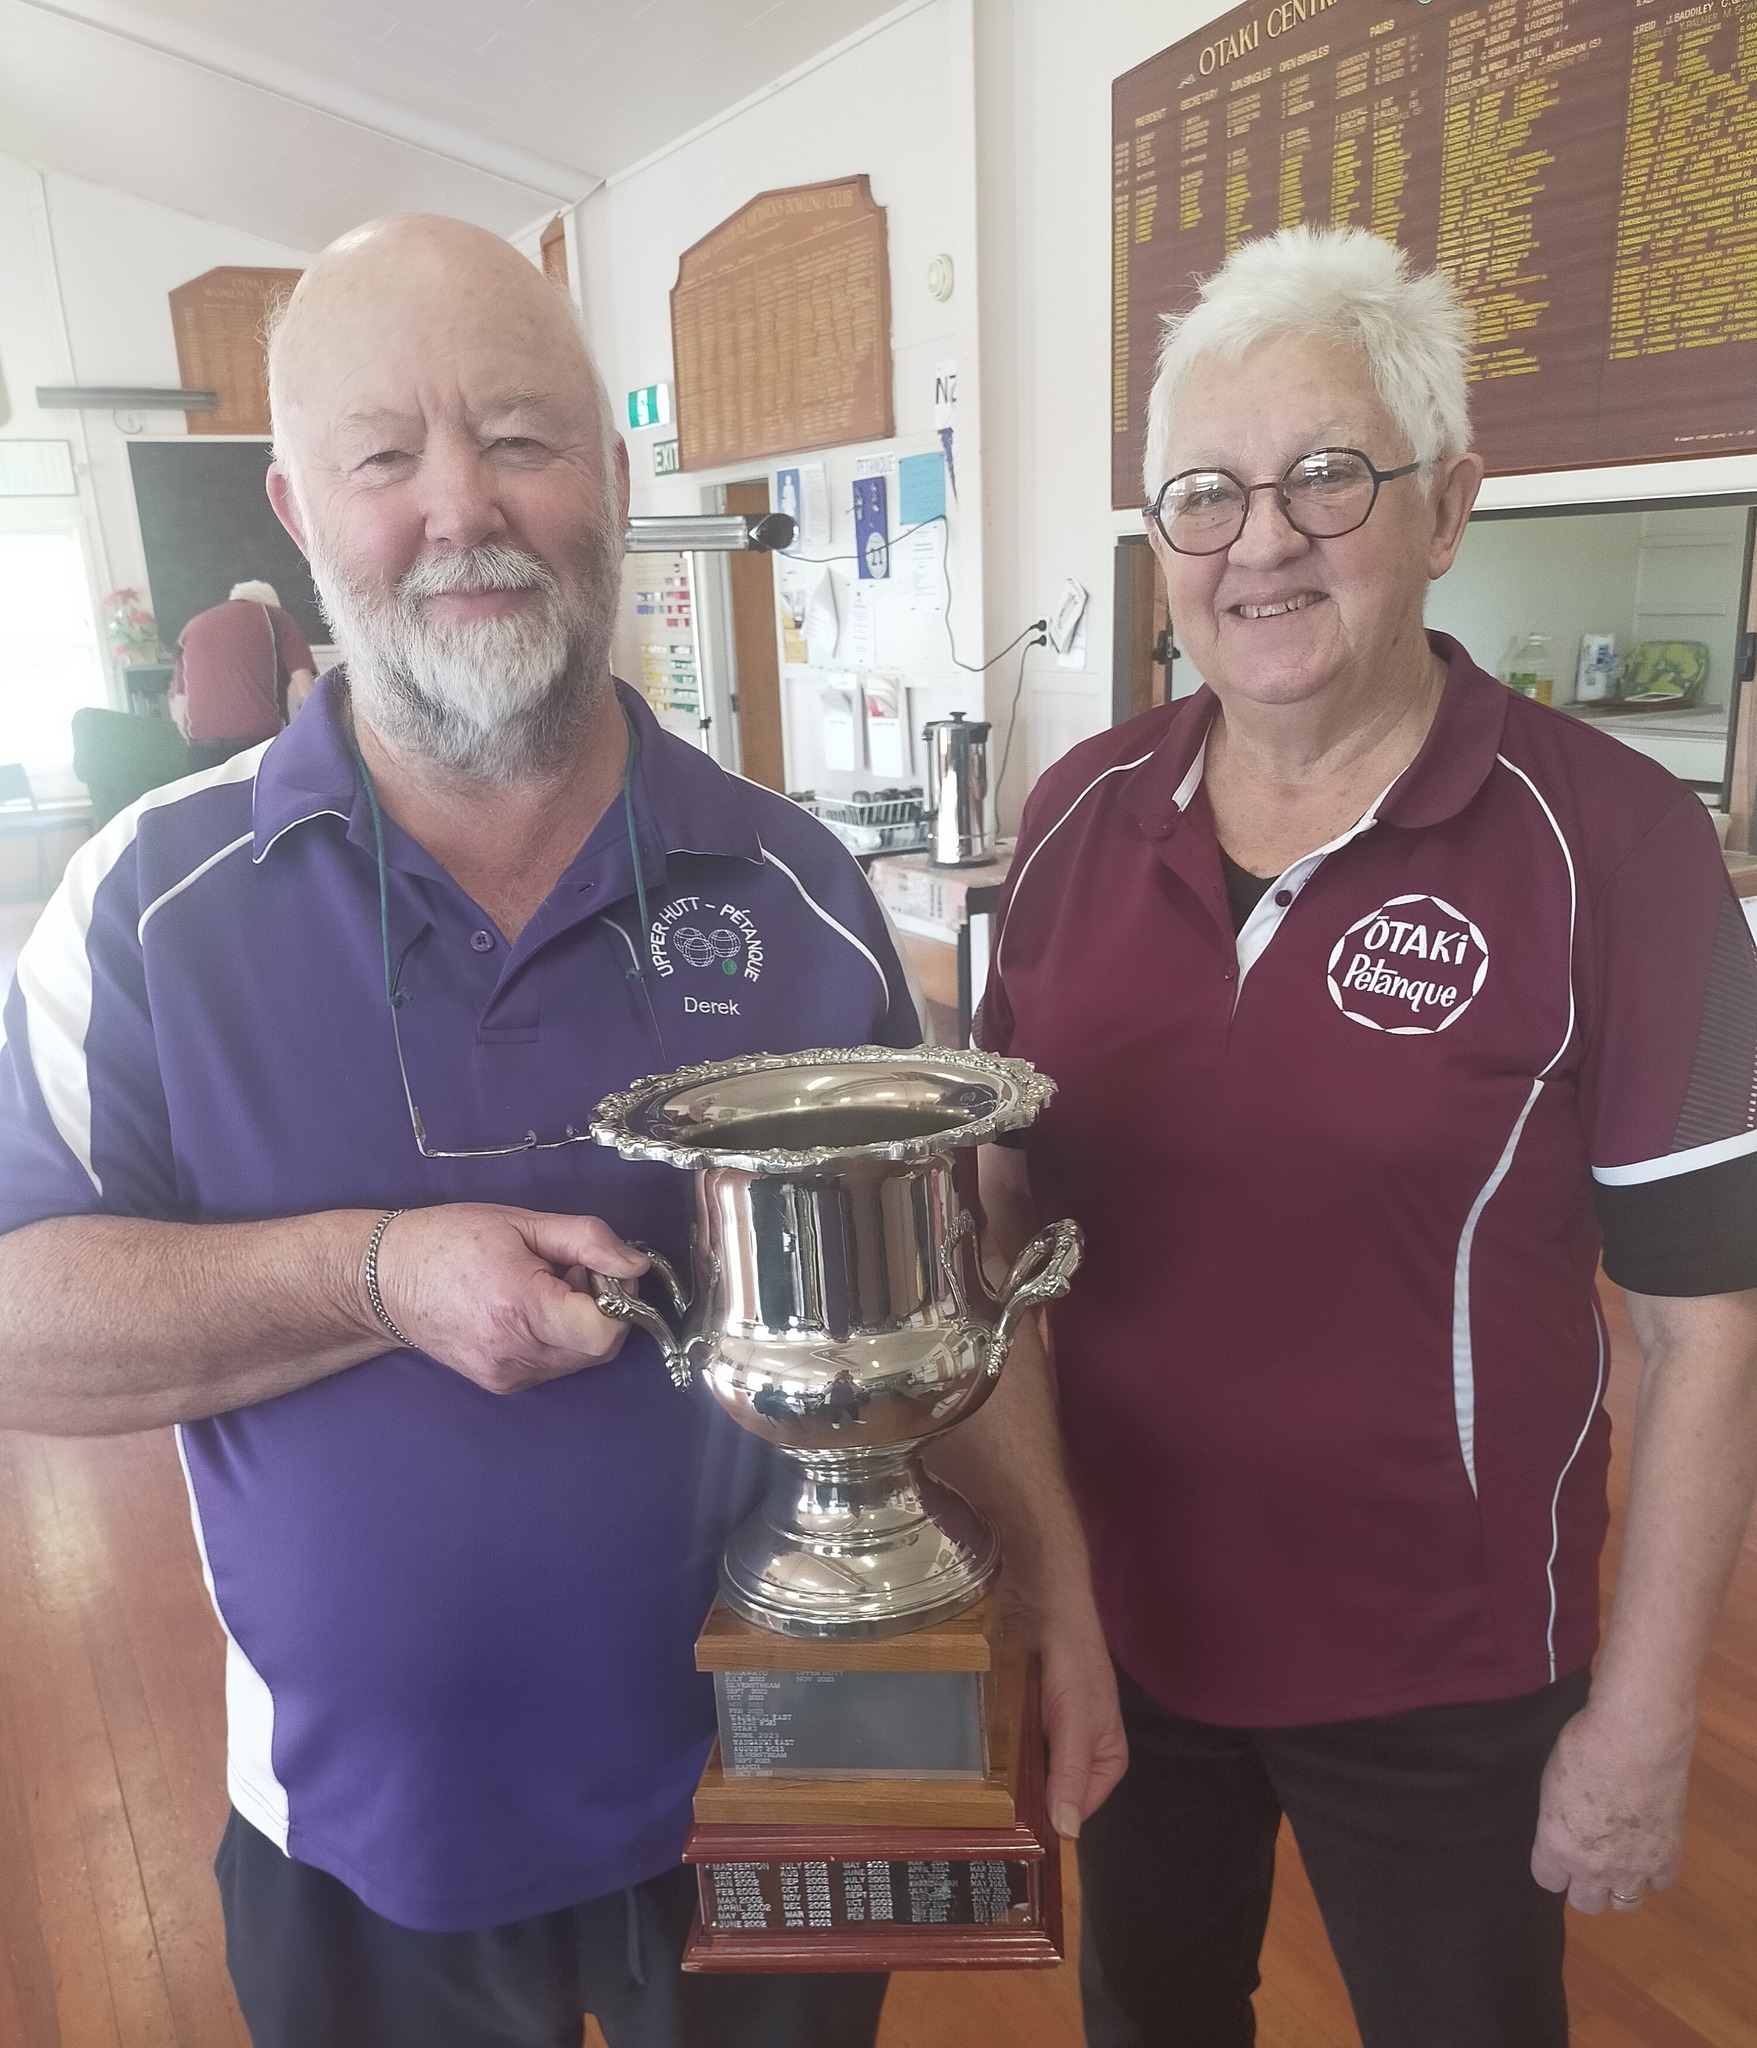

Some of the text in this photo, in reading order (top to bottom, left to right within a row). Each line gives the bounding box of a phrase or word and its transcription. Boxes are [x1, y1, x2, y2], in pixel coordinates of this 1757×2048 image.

[1369, 20, 1395, 38] PAIRS
[1199, 0, 1338, 77] OTAKI CENT
[1301, 45, 1330, 68] SINGLES
[658, 896, 700, 925] HUTT
[719, 904, 763, 983] PÉTANQUE
[650, 922, 674, 978] UPPER
[684, 996, 741, 1015] Derek
[712, 1863, 770, 1871] MASTERTON
[780, 1862, 802, 1870] JULY
[989, 1865, 1007, 1873] 2005
[714, 1872, 731, 1880] DEC
[735, 1879, 759, 1887] 2002
[806, 1877, 829, 1885] 2002
[736, 1887, 760, 1895] 2002
[994, 1887, 1011, 1895] 2005
[717, 1896, 763, 1904] MAR 2002
[717, 1904, 744, 1912] APRIL
[783, 1902, 801, 1910] DEC
[719, 1920, 767, 1928] JUNE 2002
[786, 1919, 803, 1927] APR
